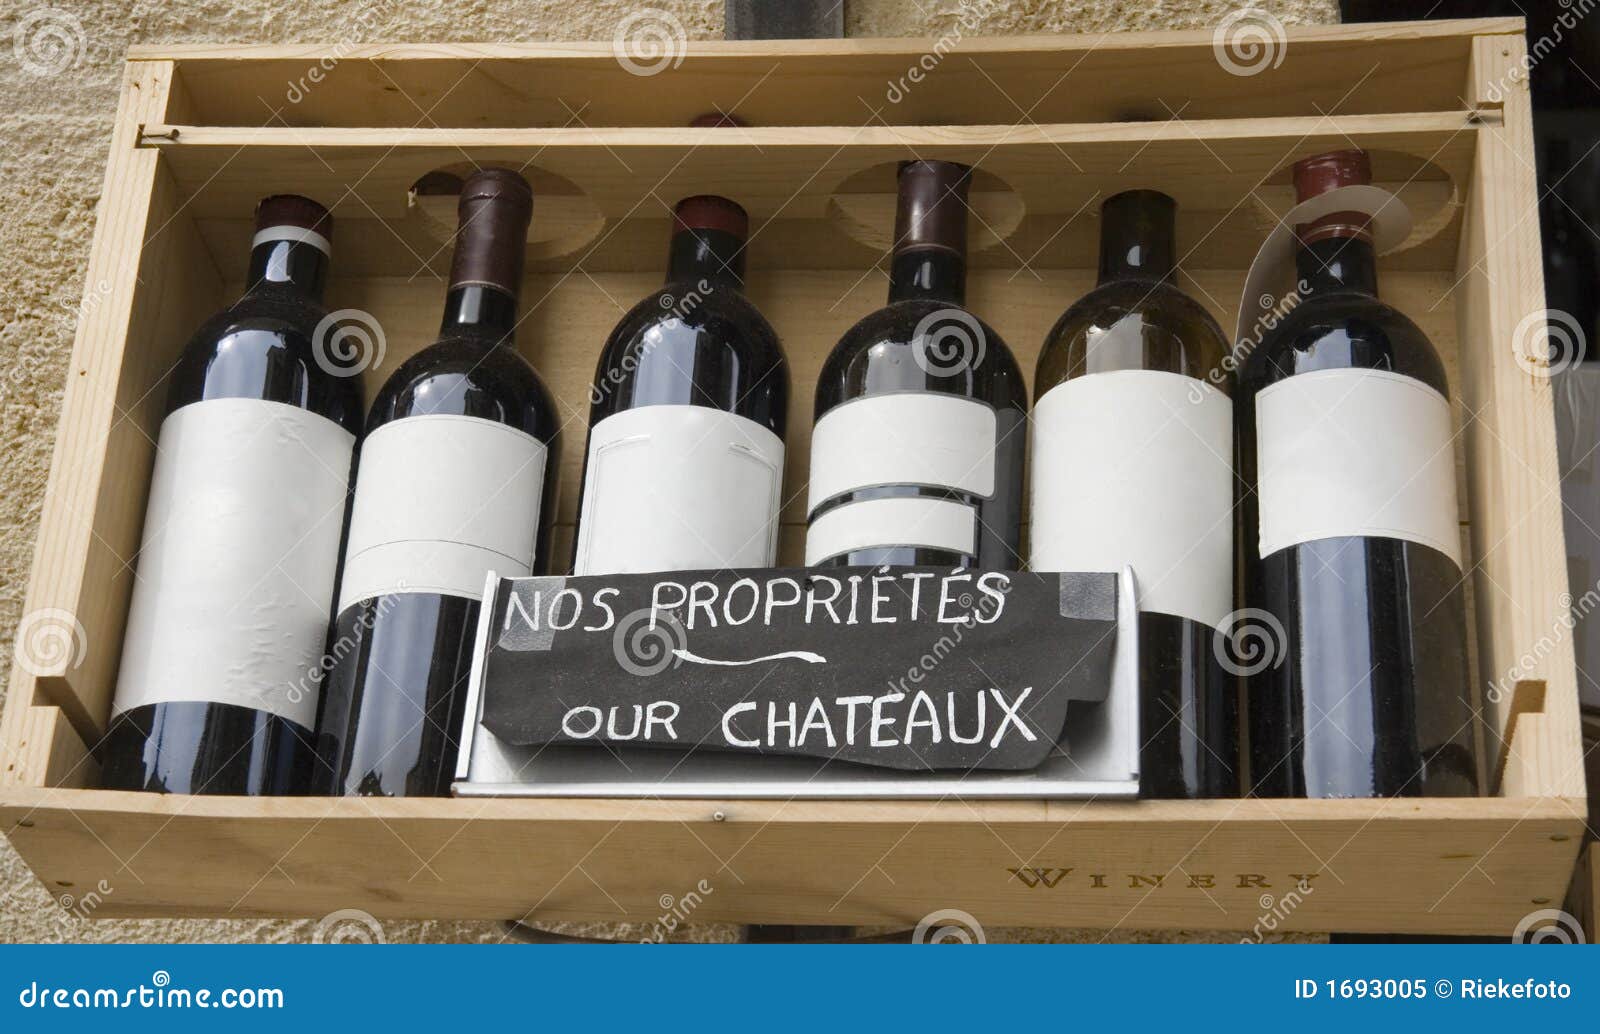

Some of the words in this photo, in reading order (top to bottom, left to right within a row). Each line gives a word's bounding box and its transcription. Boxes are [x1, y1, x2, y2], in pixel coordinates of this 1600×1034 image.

[504, 588, 620, 631] NOS
[649, 565, 1010, 631] PROPRIÉTÉS
[562, 701, 680, 740] OUR
[722, 687, 1037, 748] CHATEAUX
